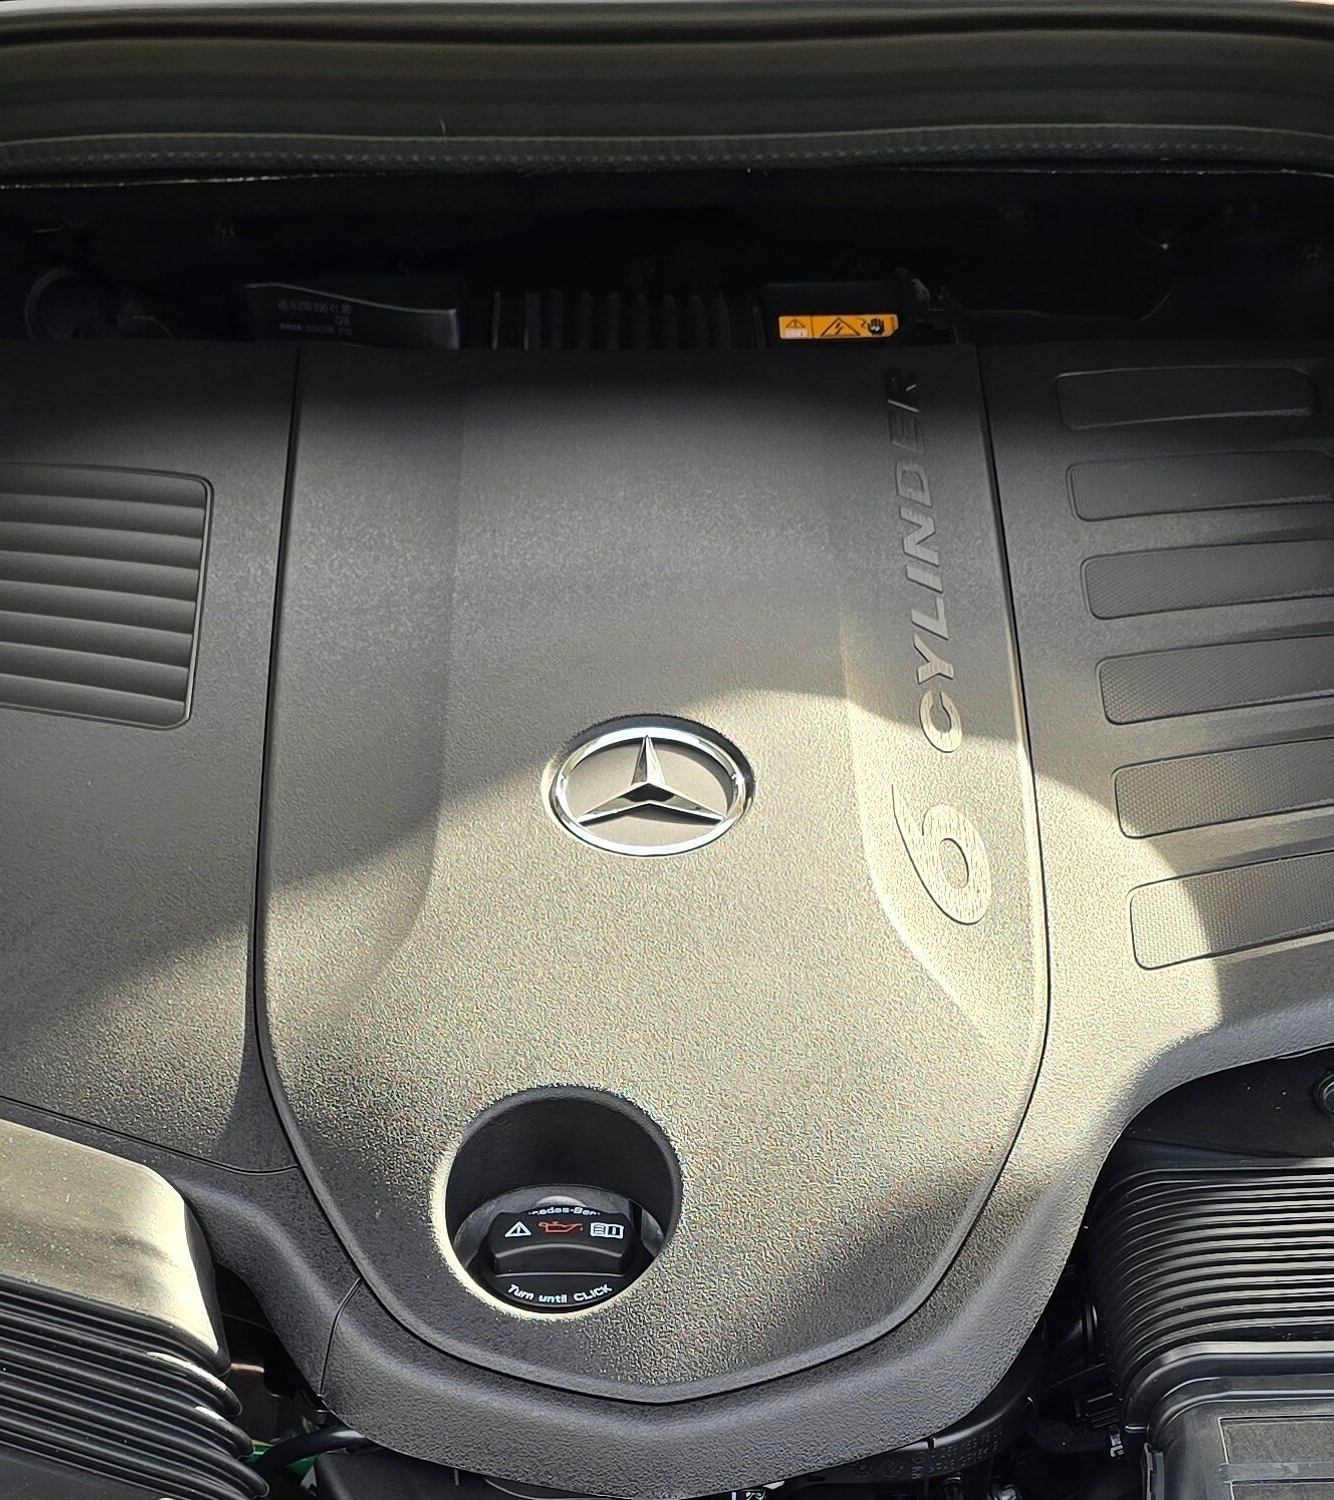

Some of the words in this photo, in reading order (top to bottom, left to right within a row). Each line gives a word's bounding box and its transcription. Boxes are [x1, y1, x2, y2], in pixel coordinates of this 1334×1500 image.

[884, 365, 964, 754] CYLINDER
[889, 782, 993, 926] 6
[507, 1283, 534, 1301] Turn
[538, 1294, 567, 1303] until
[574, 1284, 612, 1301] CLICK
